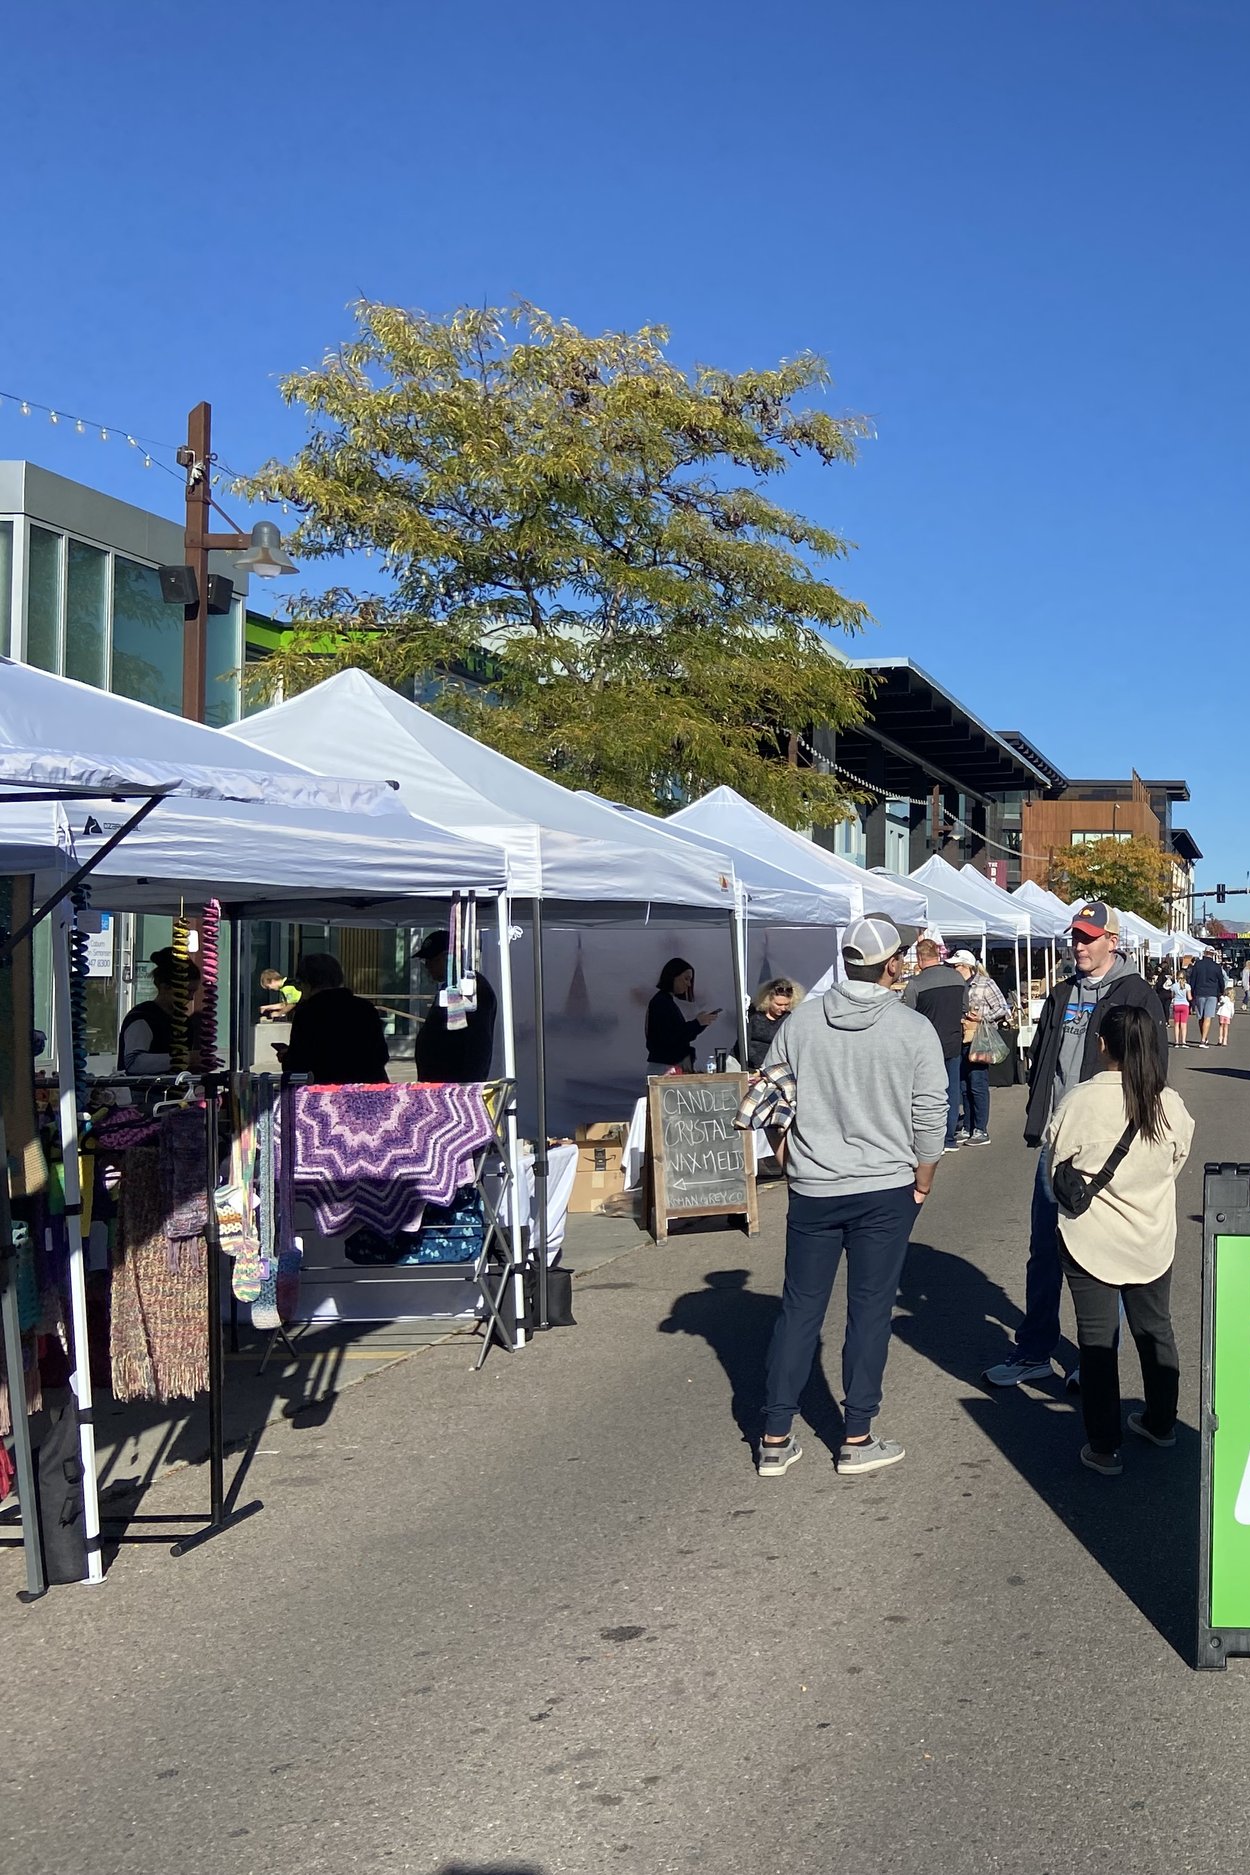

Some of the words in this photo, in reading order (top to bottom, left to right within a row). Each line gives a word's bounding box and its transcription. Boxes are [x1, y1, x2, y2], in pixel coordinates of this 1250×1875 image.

[663, 1088, 738, 1115] CANDLES
[665, 1116, 741, 1148] CRYSTALS
[665, 1151, 702, 1174] WAX
[703, 1150, 744, 1173] MELTS
[729, 1192, 743, 1203] CO
